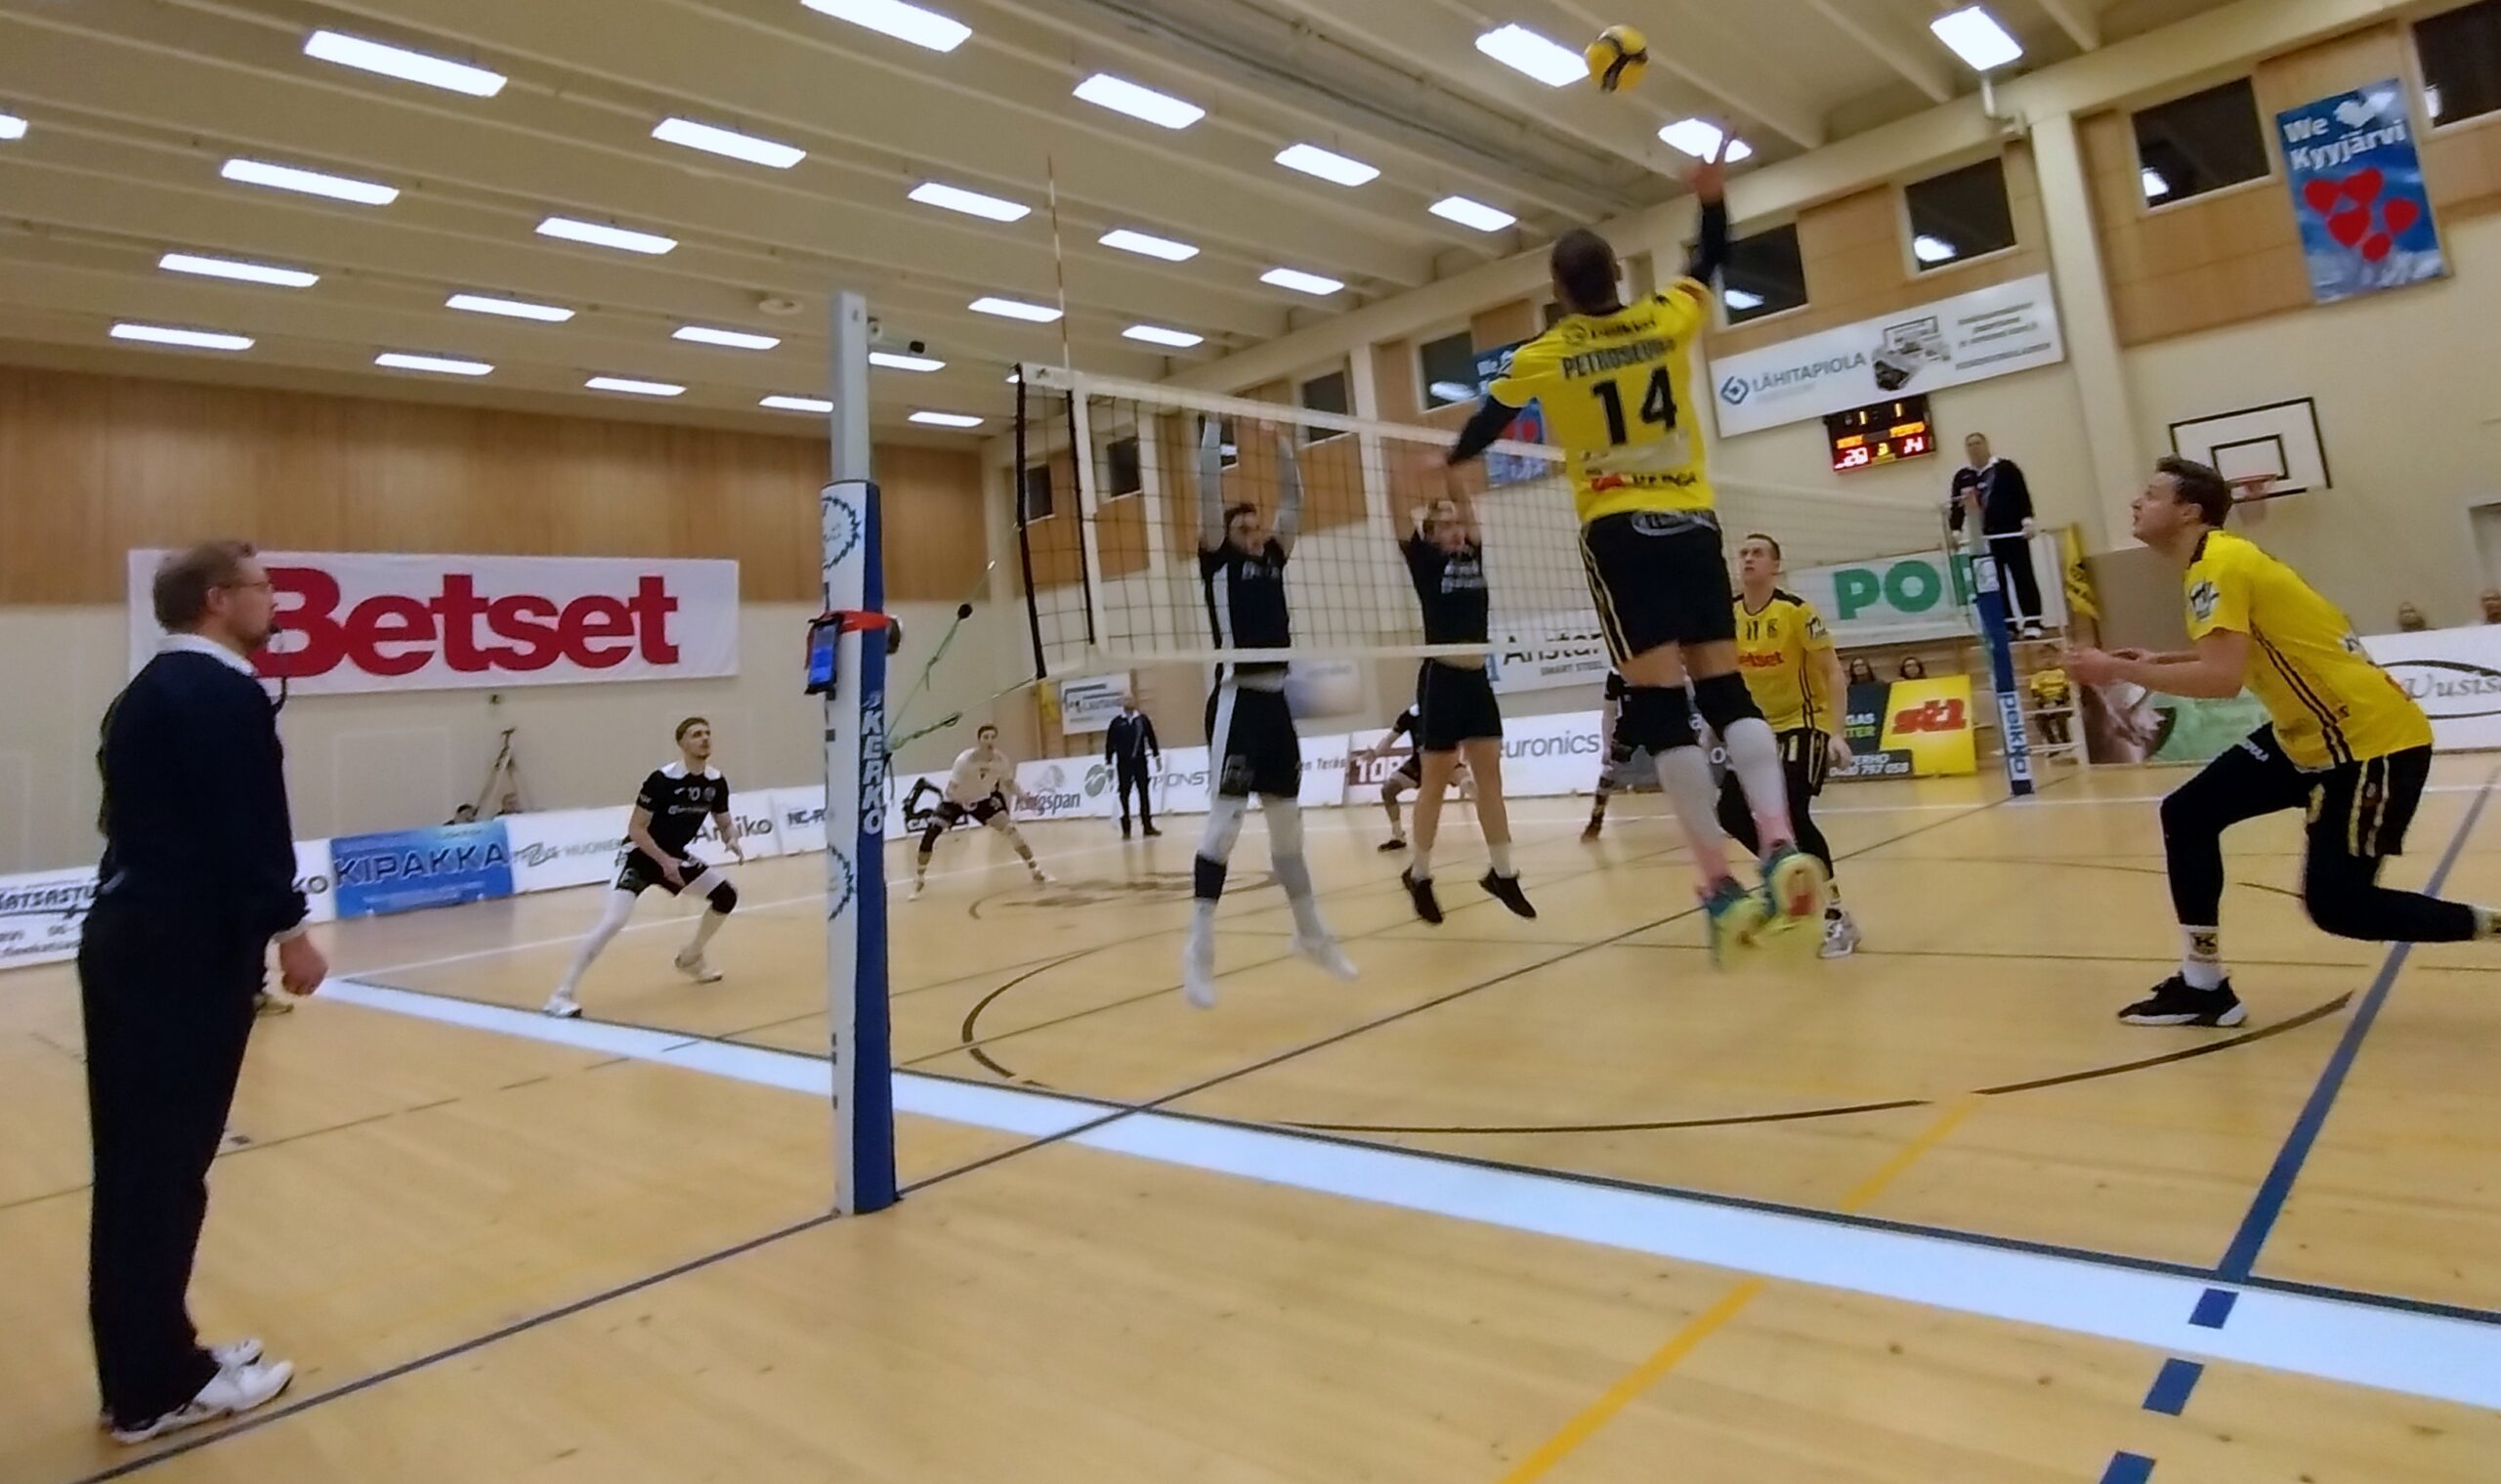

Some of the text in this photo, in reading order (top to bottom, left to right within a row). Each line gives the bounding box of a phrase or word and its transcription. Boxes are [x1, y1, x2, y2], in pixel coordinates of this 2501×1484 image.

[2283, 116, 2329, 144] We
[2290, 119, 2407, 170] Kyyjärvi
[1752, 352, 1868, 393] LÄHITAPIOLA
[1590, 364, 1678, 446] 14
[254, 567, 679, 678] Betset
[1737, 651, 1785, 667] etset
[2404, 673, 2501, 699] Uusis
[2000, 693, 2027, 774] peikko
[334, 842, 510, 888] KIPAKKA
